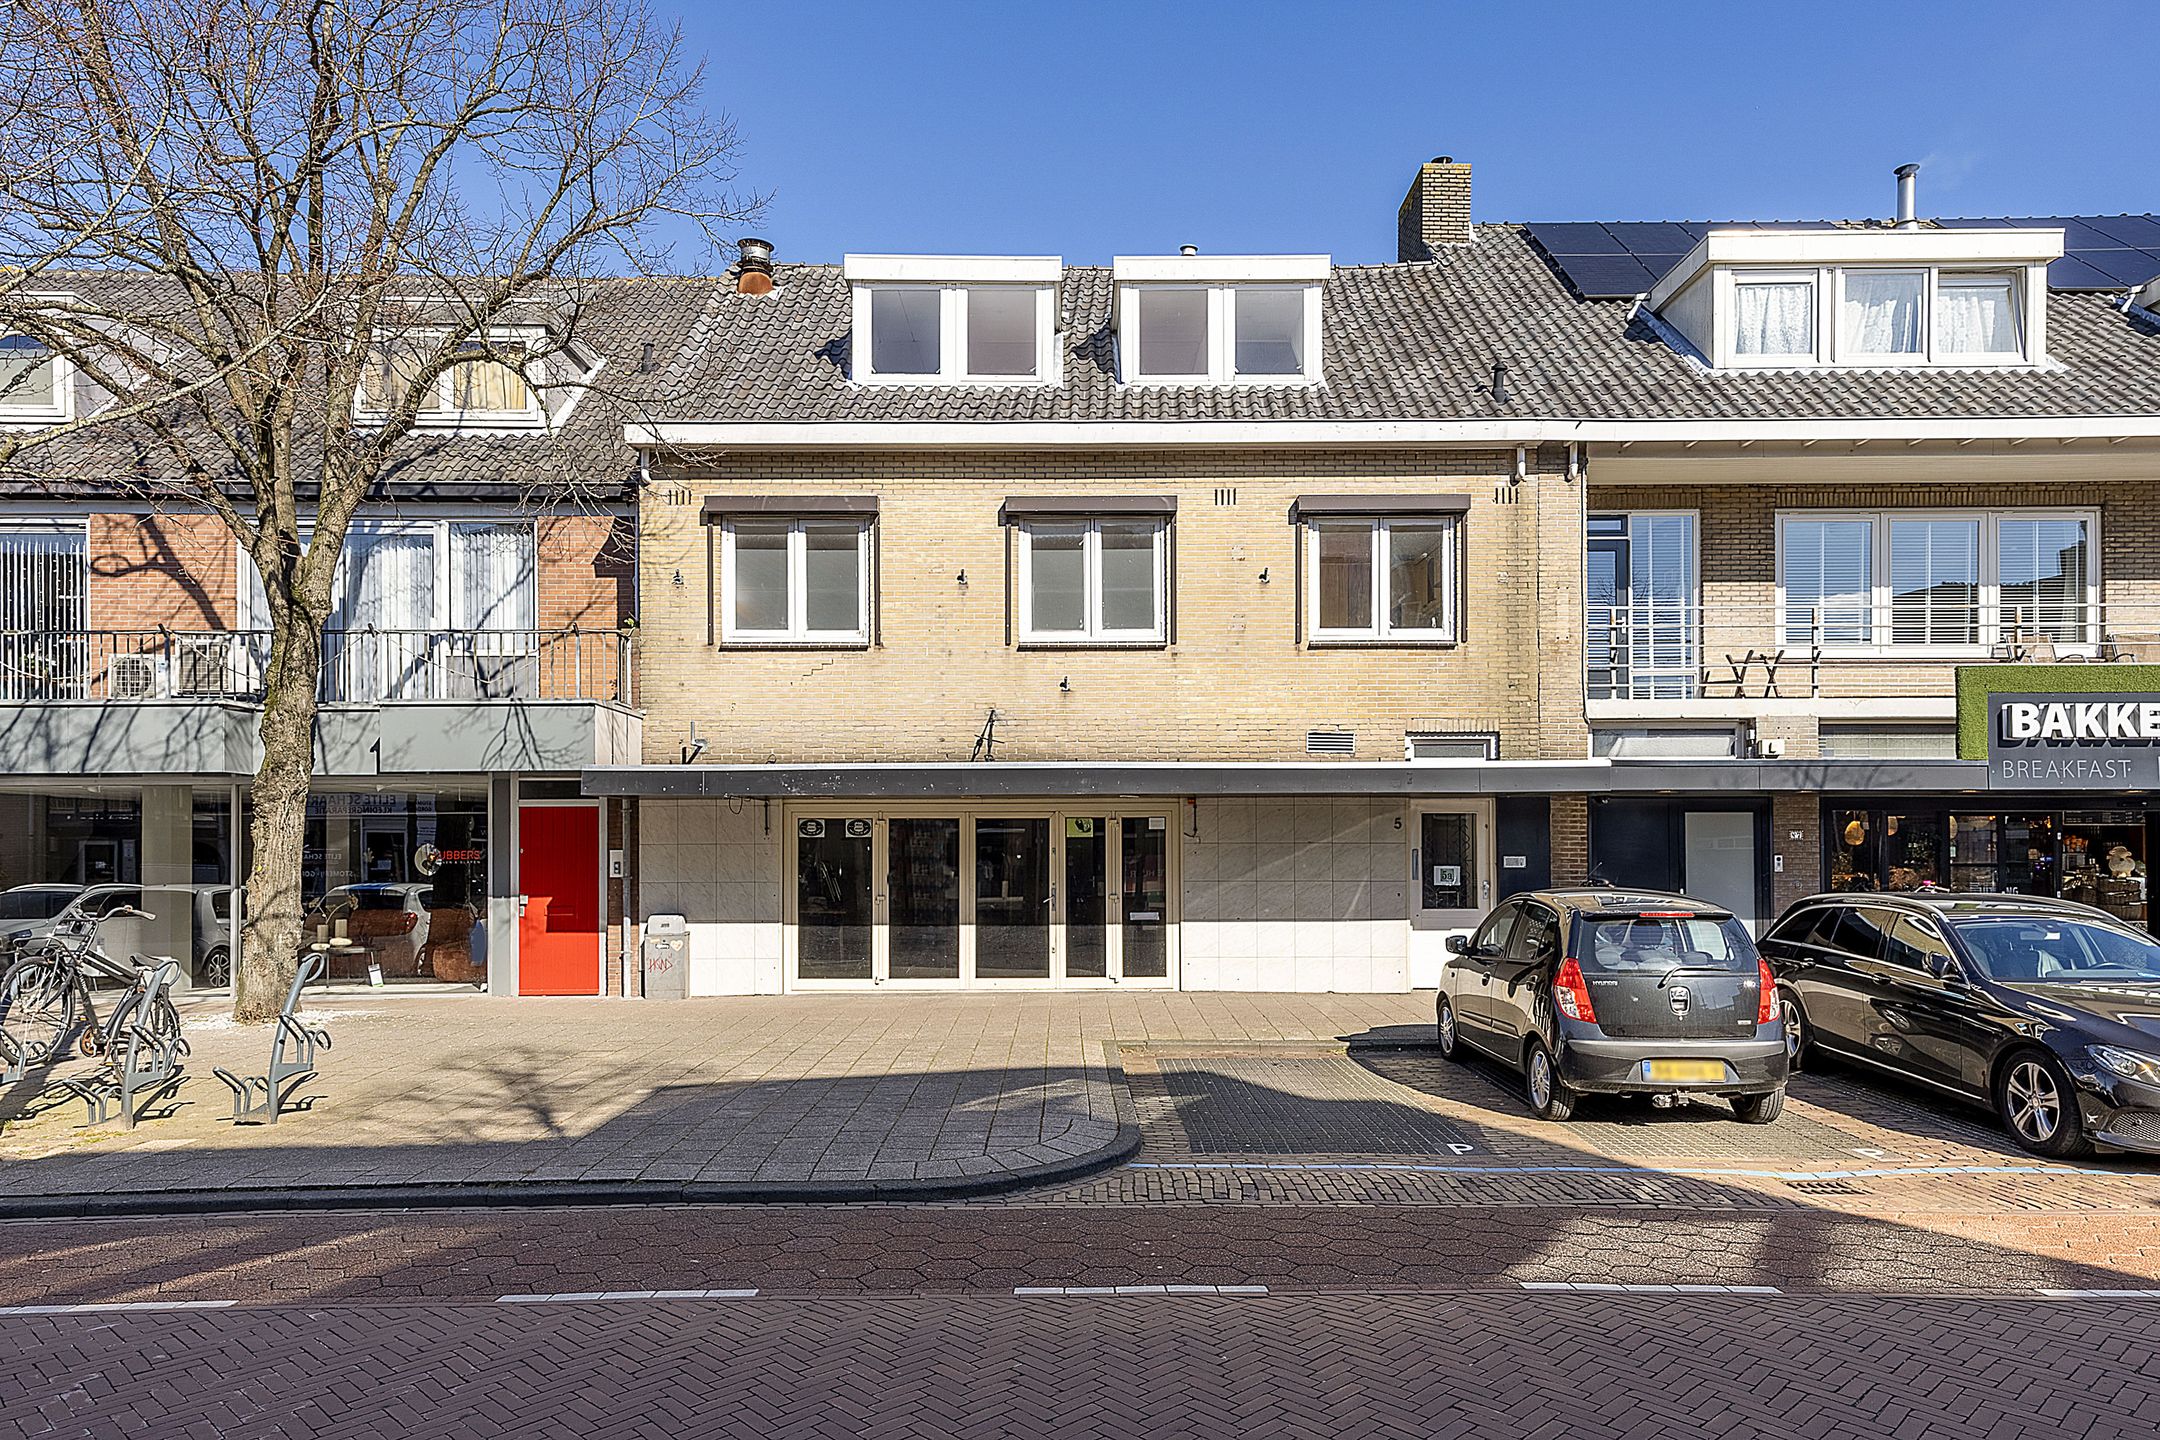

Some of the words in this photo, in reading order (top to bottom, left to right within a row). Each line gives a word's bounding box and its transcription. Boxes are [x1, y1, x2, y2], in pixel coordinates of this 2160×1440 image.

[2003, 703, 2160, 740] BAKKE
[2002, 760, 2131, 779] BREAKFAST
[1394, 818, 1402, 829] 5
[434, 850, 480, 860] UBBERS
[1441, 870, 1453, 880] 5a
